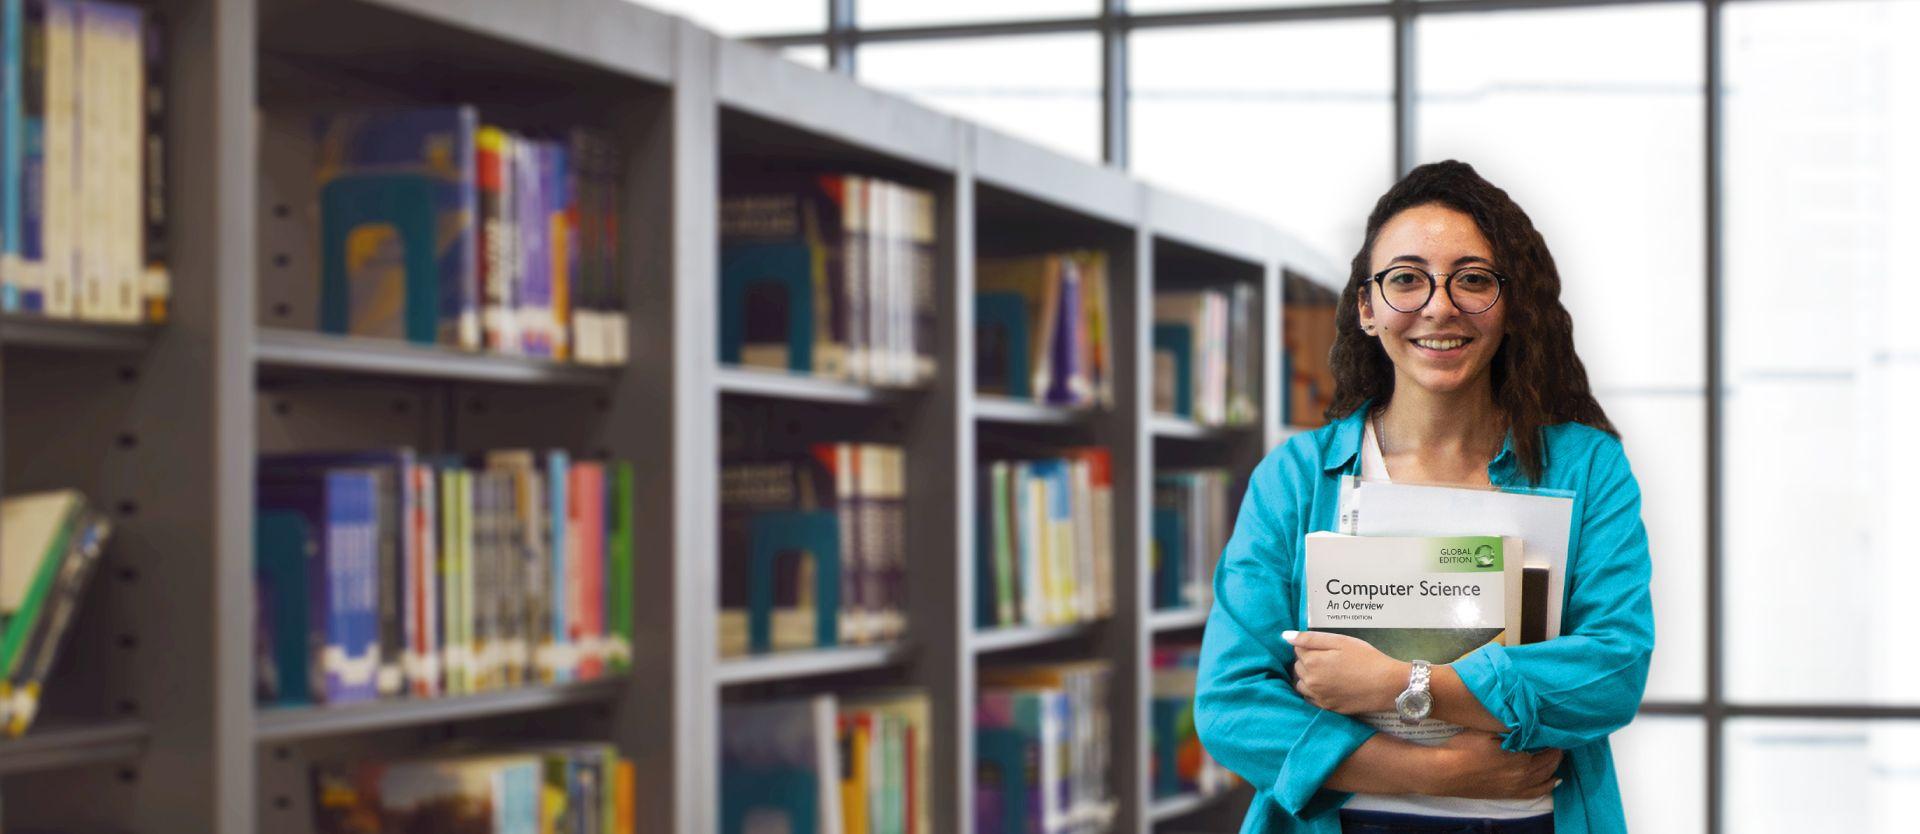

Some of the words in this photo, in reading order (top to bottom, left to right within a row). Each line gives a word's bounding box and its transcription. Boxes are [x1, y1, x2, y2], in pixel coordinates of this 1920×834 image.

[1440, 548, 1472, 556] GLOBAL
[1439, 556, 1472, 564] EDITION
[1326, 579, 1414, 600] Computer
[1420, 580, 1481, 596] Science
[1326, 600, 1340, 610] An
[1342, 599, 1384, 610] Overview
